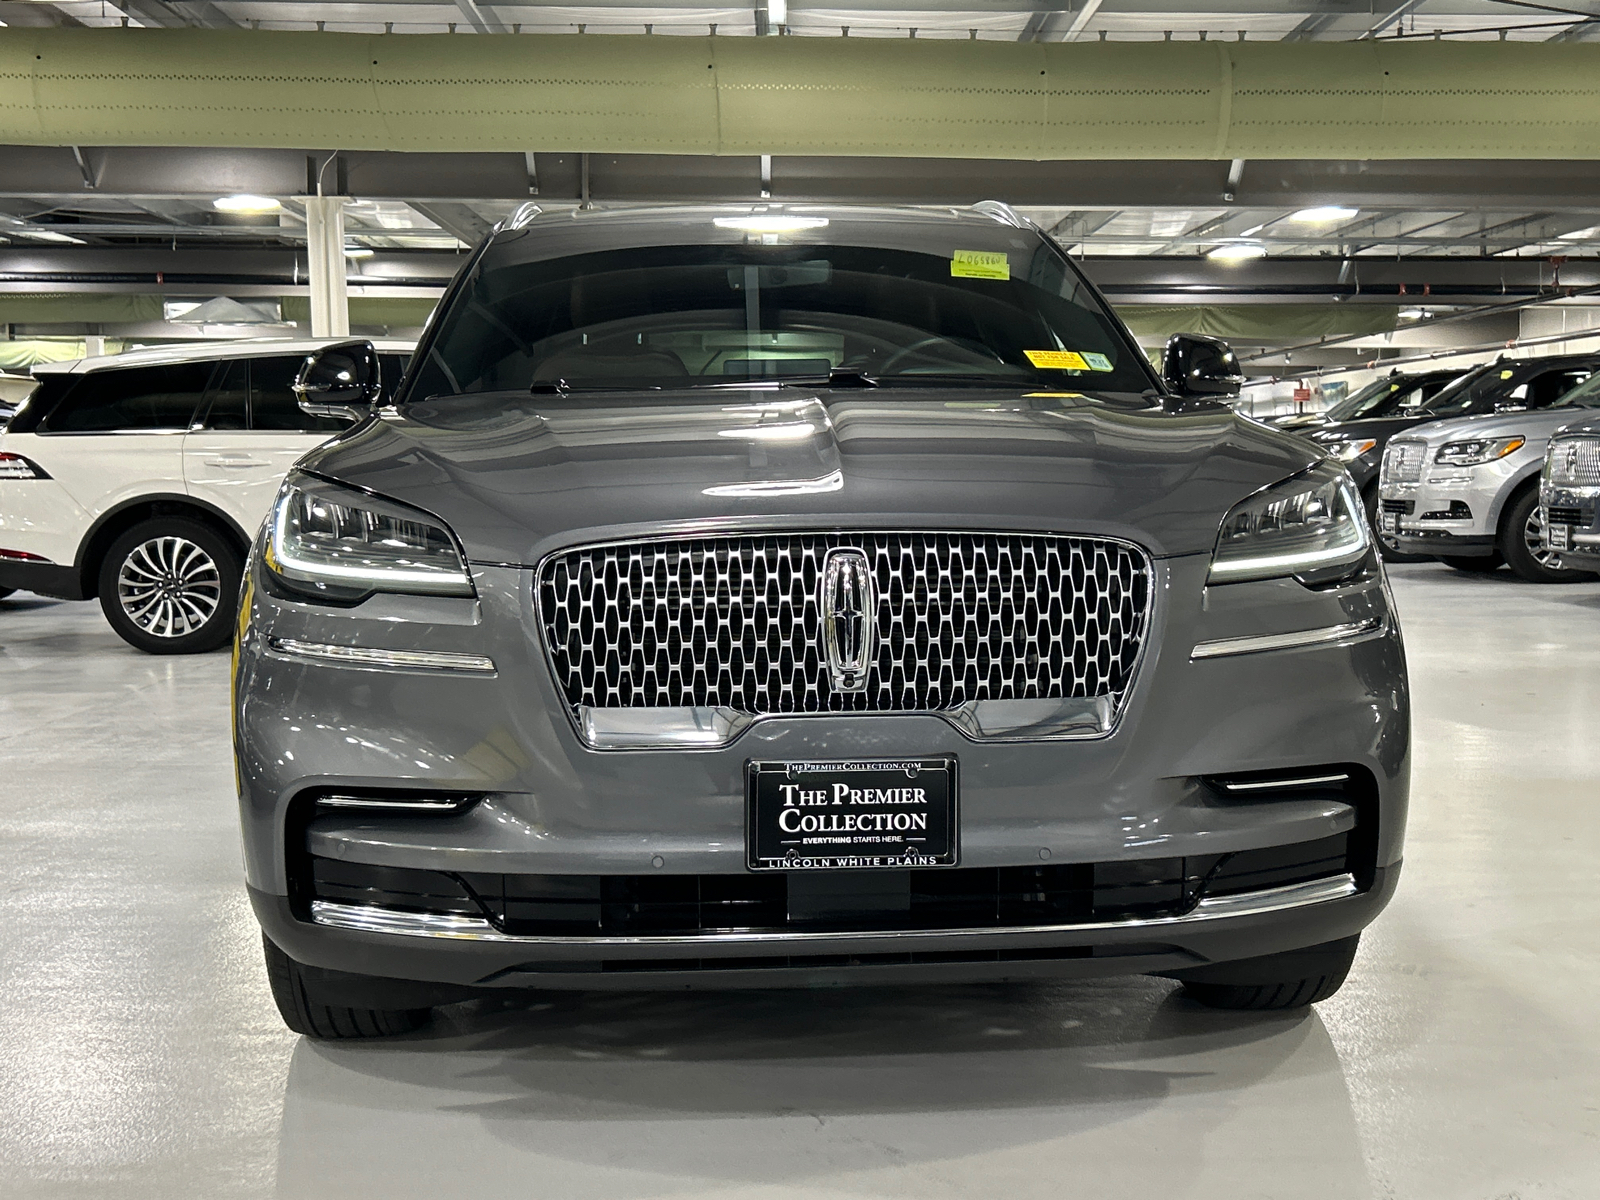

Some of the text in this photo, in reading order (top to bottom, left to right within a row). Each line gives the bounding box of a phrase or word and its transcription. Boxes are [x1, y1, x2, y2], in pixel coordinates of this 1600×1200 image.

[779, 808, 927, 833] COLLECTION
[802, 836, 852, 845] EVERYTHING
[853, 836, 881, 844] STARTS
[769, 856, 937, 868] LINCOLN WHITE PLAINS
